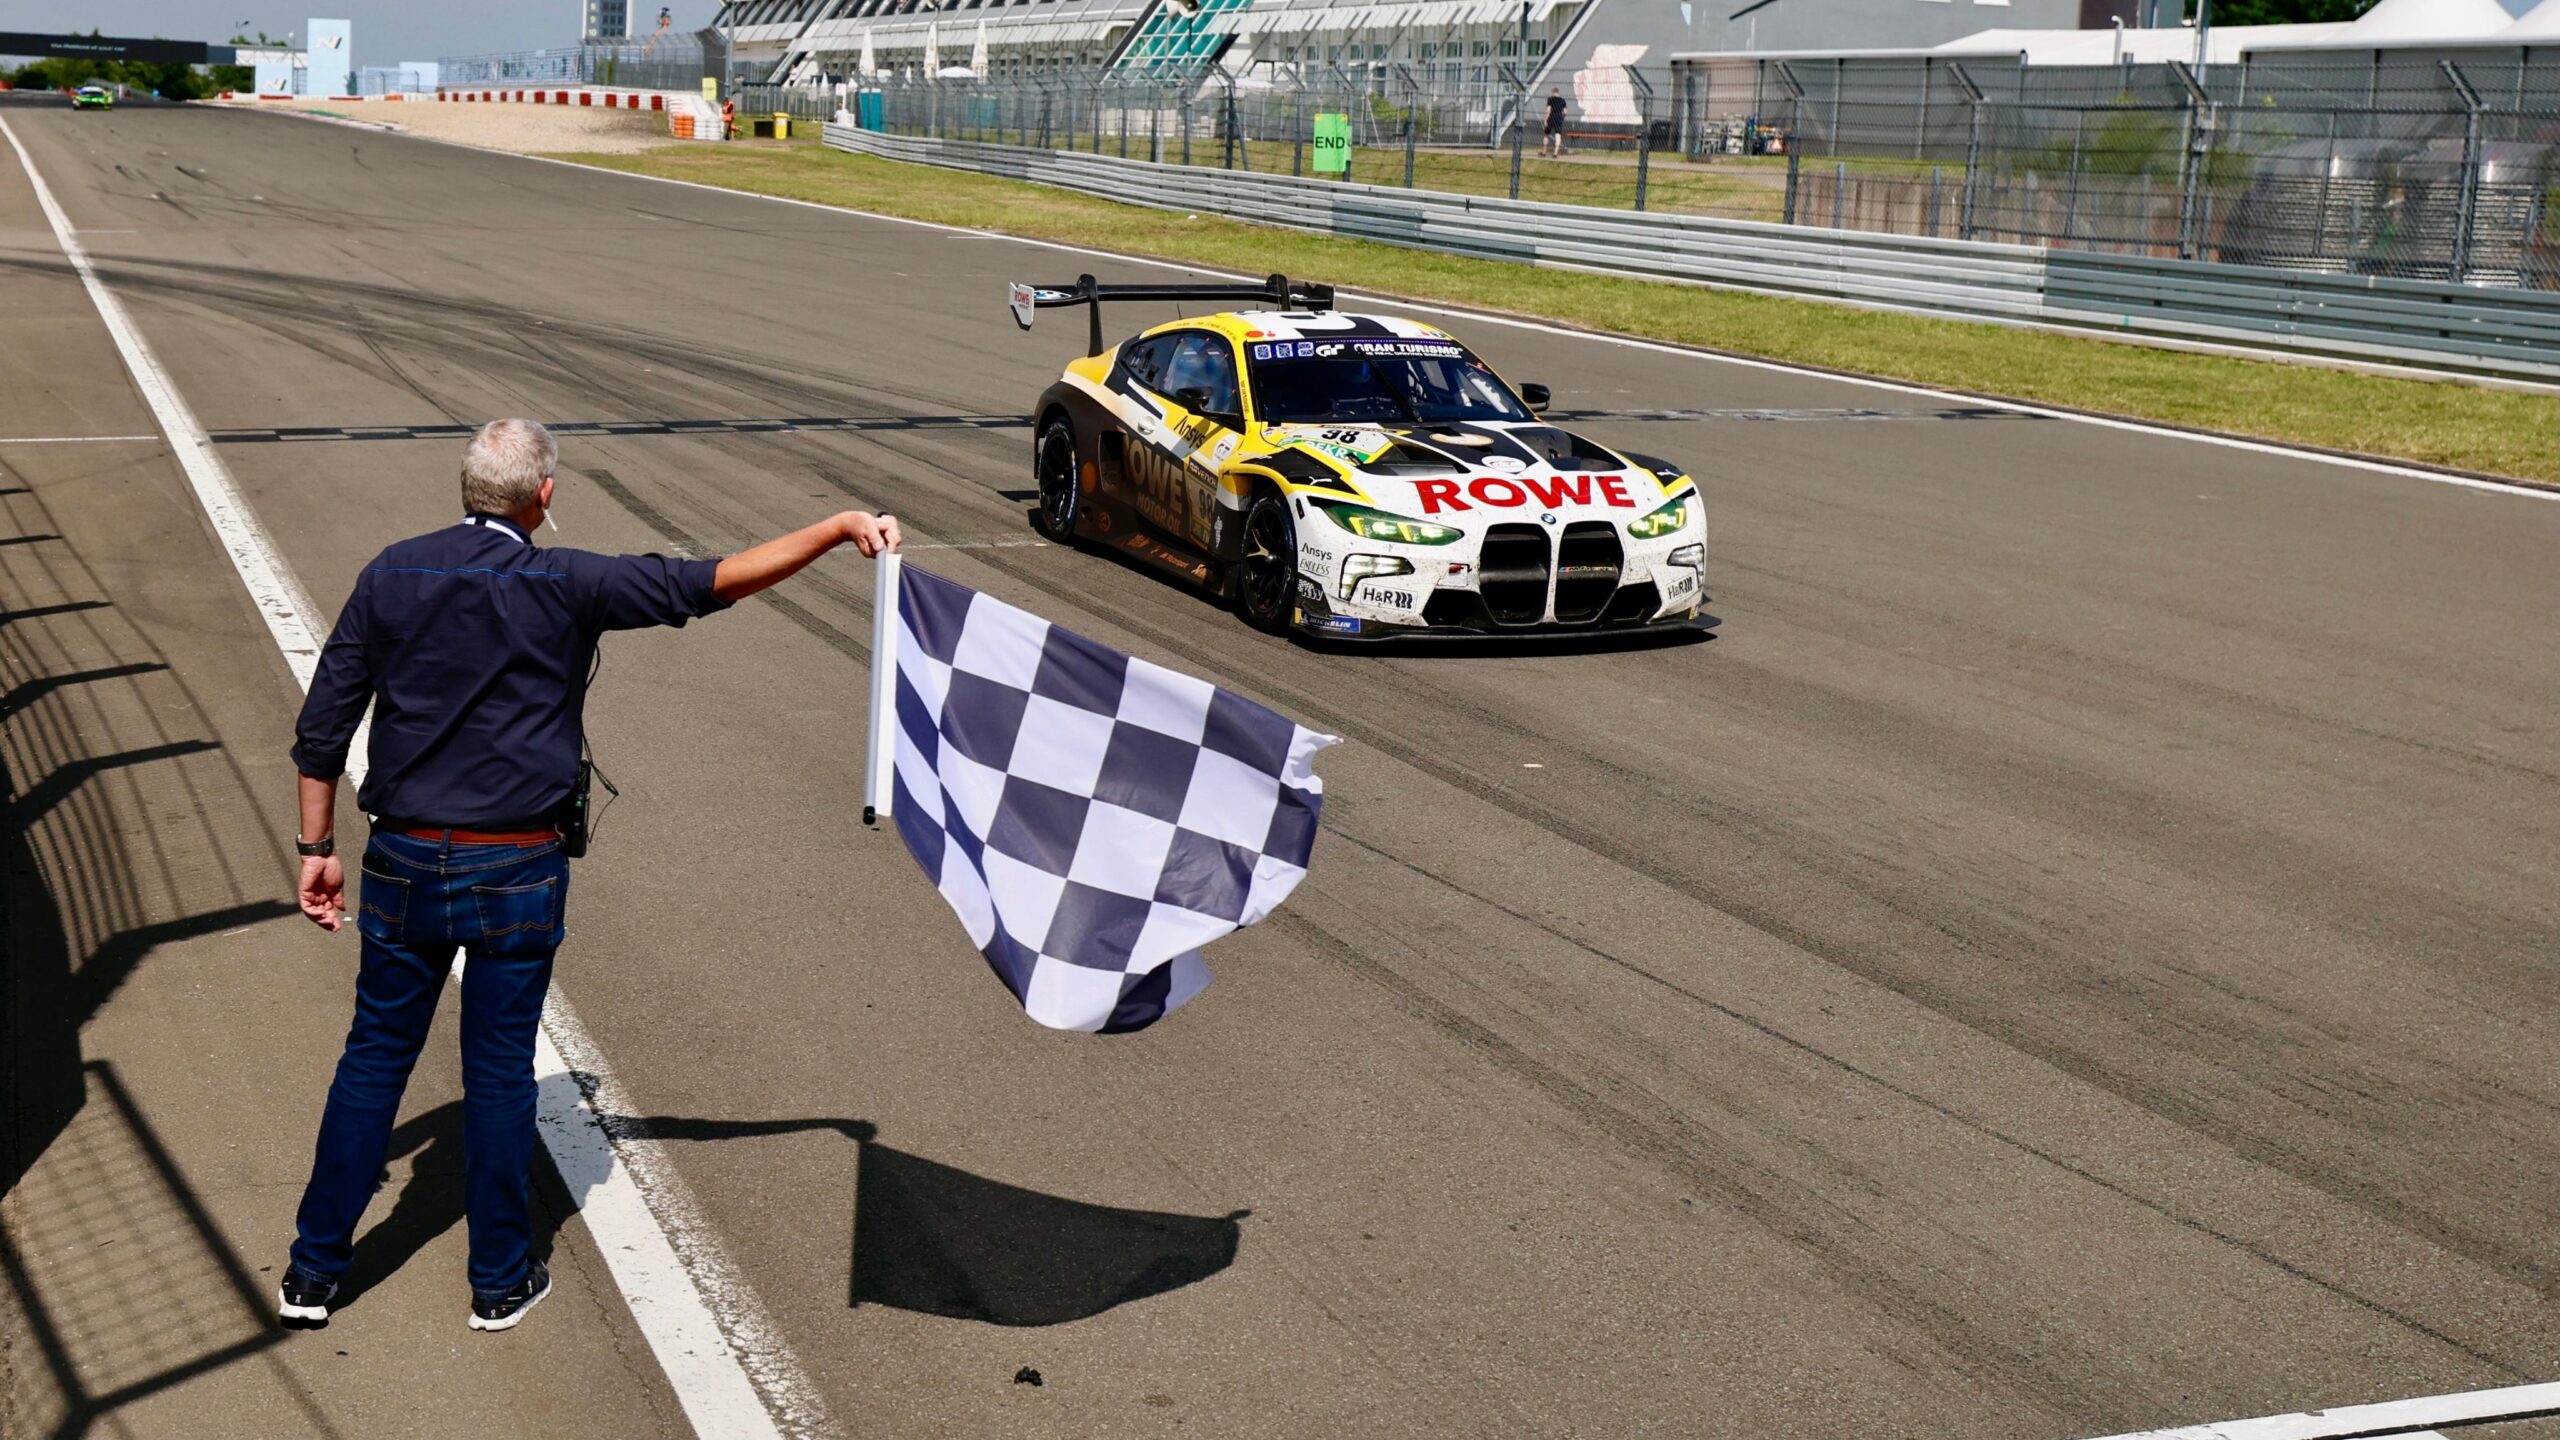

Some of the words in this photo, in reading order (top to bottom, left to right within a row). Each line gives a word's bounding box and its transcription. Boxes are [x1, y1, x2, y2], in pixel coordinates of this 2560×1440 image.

[1315, 136, 1346, 149] END
[1173, 416, 1206, 448] Ansys
[1411, 475, 1637, 514] ROWE
[1136, 492, 1168, 521] MOTOR
[1300, 542, 1333, 561] Ansys
[1300, 559, 1331, 577] ENDLESS
[1363, 586, 1394, 605] H&R
[1667, 579, 1686, 600] H&R
[1309, 616, 1352, 628] MICHELIN
